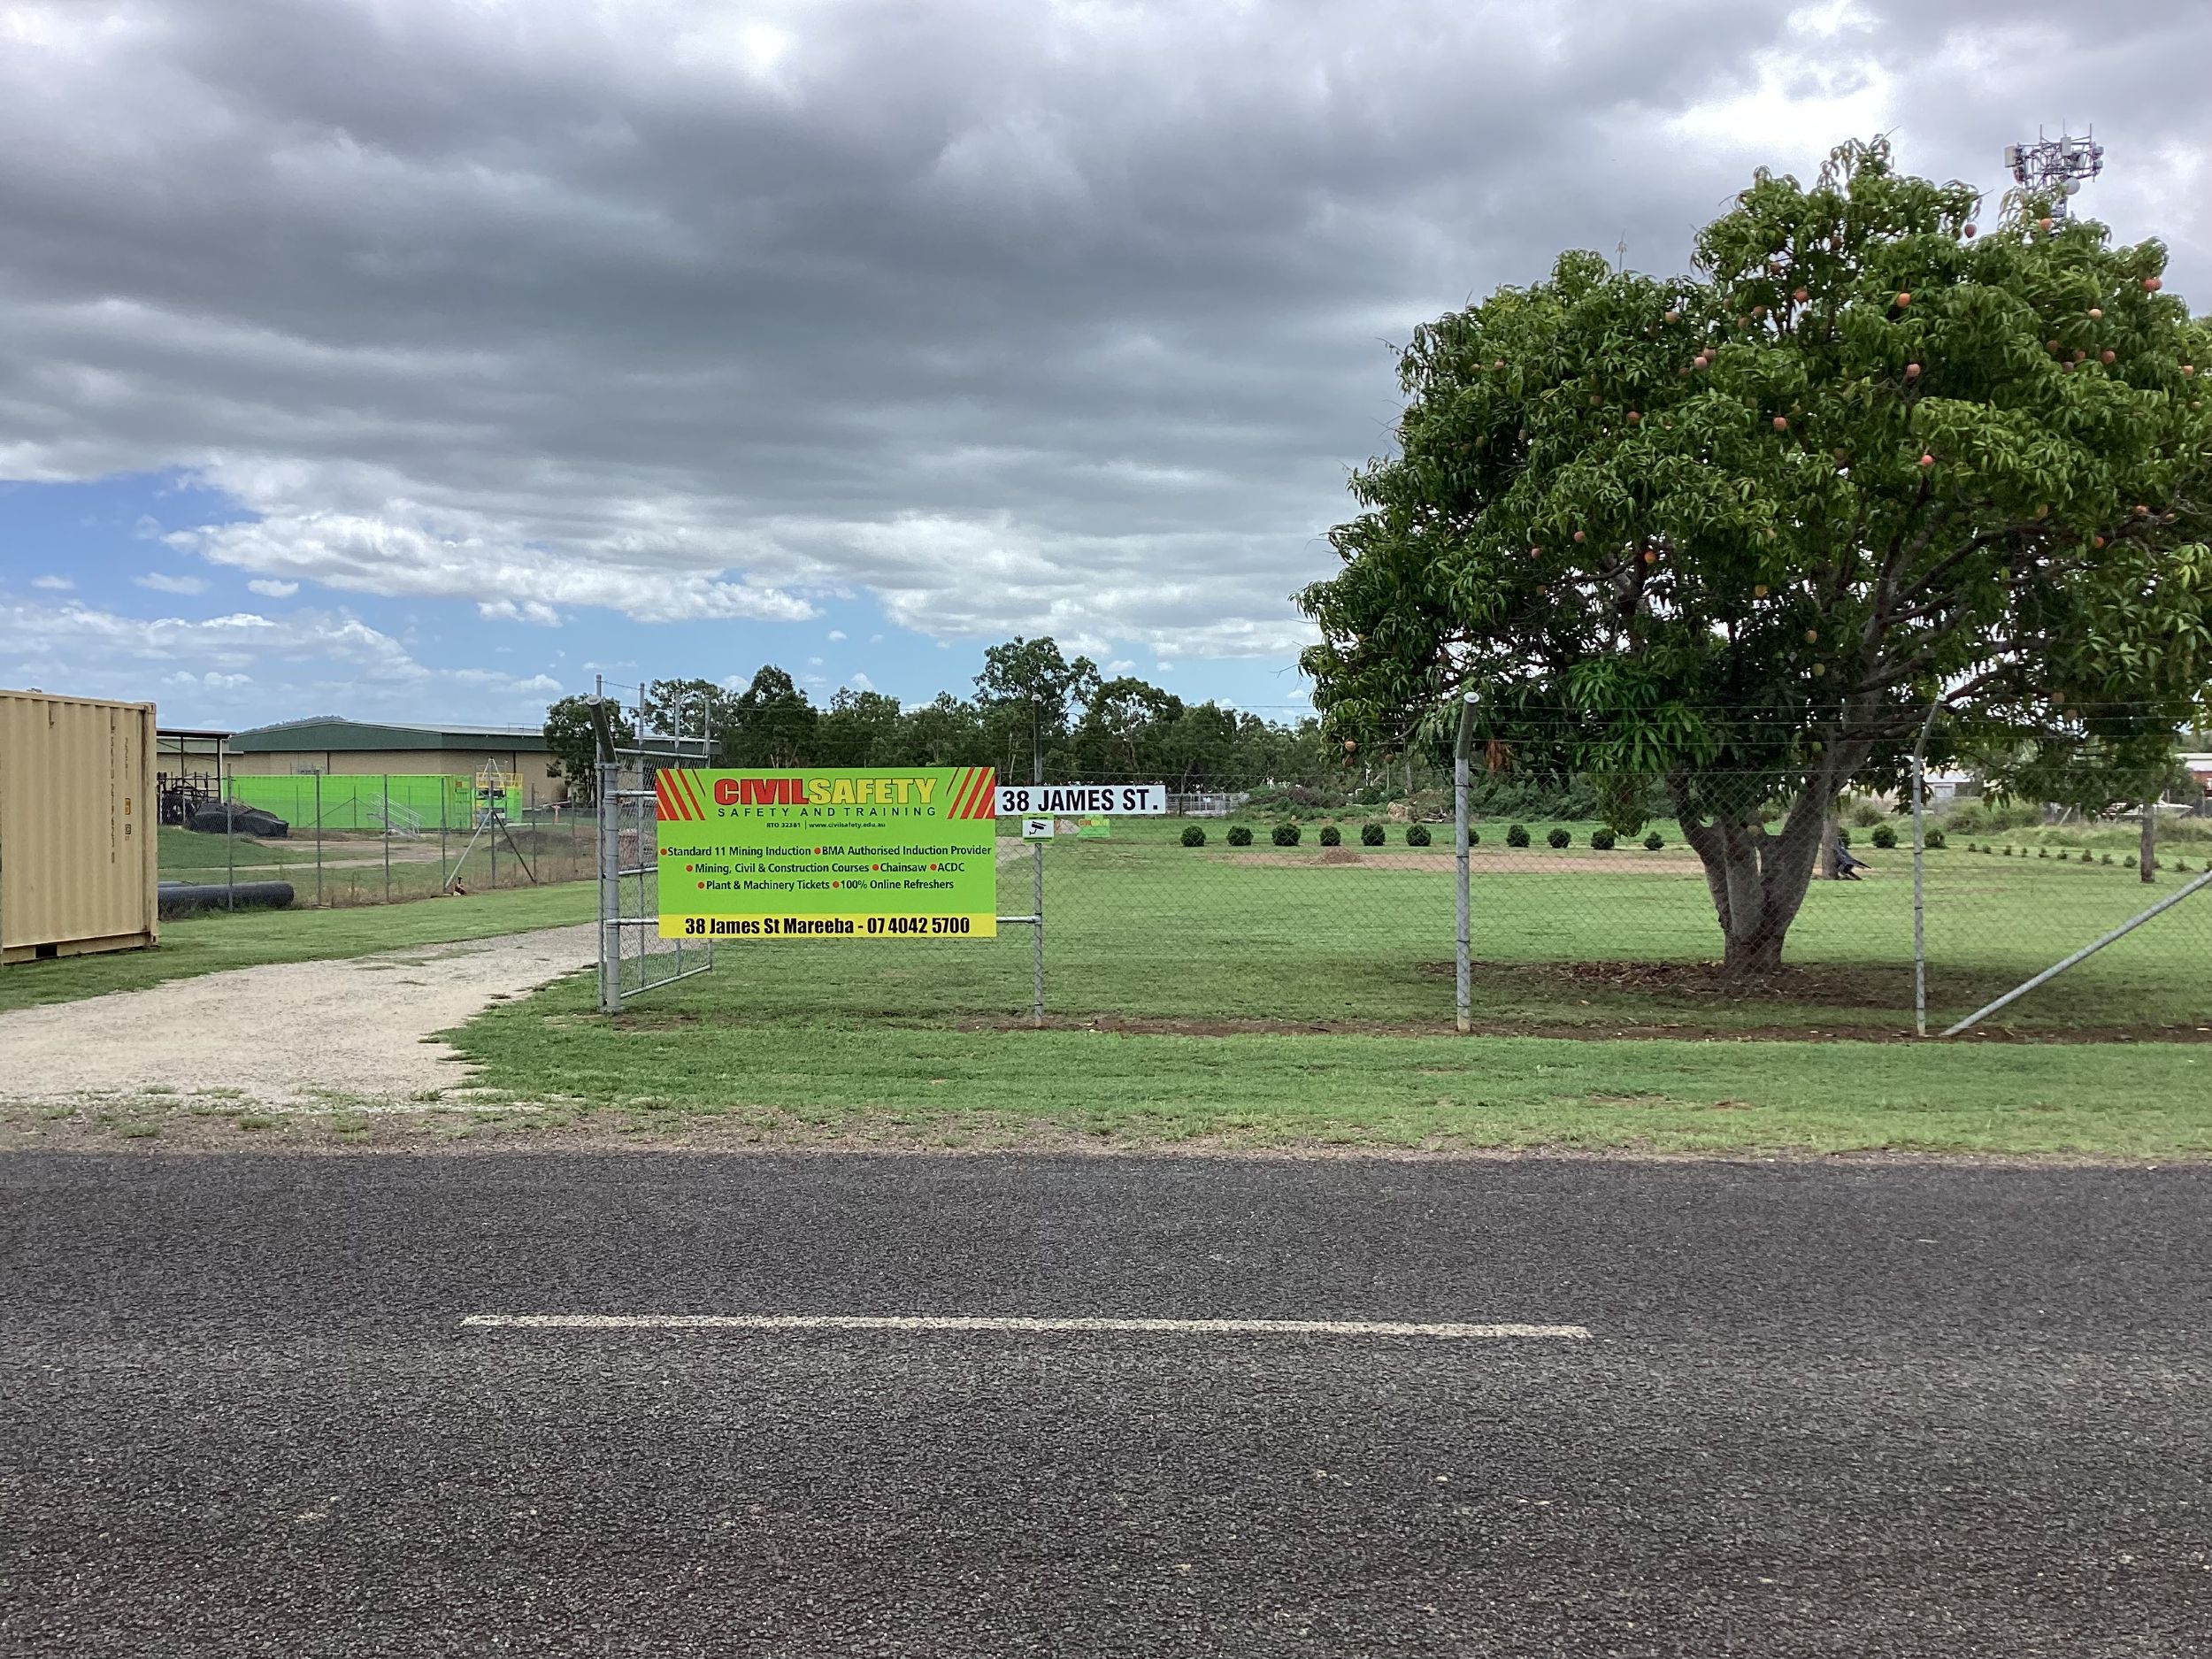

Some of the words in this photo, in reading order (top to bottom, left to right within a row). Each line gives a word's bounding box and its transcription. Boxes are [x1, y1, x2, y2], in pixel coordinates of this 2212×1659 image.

[1002, 790, 1030, 811] 38
[1038, 788, 1114, 811] JAMES
[1123, 788, 1158, 810] ST.
[718, 808, 789, 818] SAFETY
[800, 808, 836, 817] AND
[844, 807, 935, 817] TRAINING
[667, 846, 712, 856] Standard
[715, 846, 726, 856] 11
[729, 846, 763, 858] Mining
[765, 846, 811, 856] Induction
[822, 846, 845, 856] BMA
[848, 845, 900, 856] Authorised
[902, 845, 949, 855] Induction
[950, 845, 992, 855] Provider
[695, 864, 732, 875] Mining,
[734, 863, 755, 873] Civil
[758, 864, 765, 873] &
[768, 863, 829, 872] Construction
[832, 863, 870, 872] Courses
[880, 863, 927, 872] Chainsaw
[937, 863, 965, 872] ACDC
[706, 880, 731, 890] Plant
[733, 880, 741, 890] &
[743, 880, 795, 892] Machinery
[797, 879, 830, 889] Tickets
[841, 879, 868, 889] 100%
[870, 879, 901, 889] Online
[903, 879, 954, 889] Refreshers
[685, 918, 706, 934] 38
[709, 918, 760, 934] James
[764, 918, 780, 934] St
[783, 918, 854, 934] Mareeba
[867, 918, 886, 933] 07
[887, 918, 928, 933] 4042
[932, 917, 971, 933] 5700
